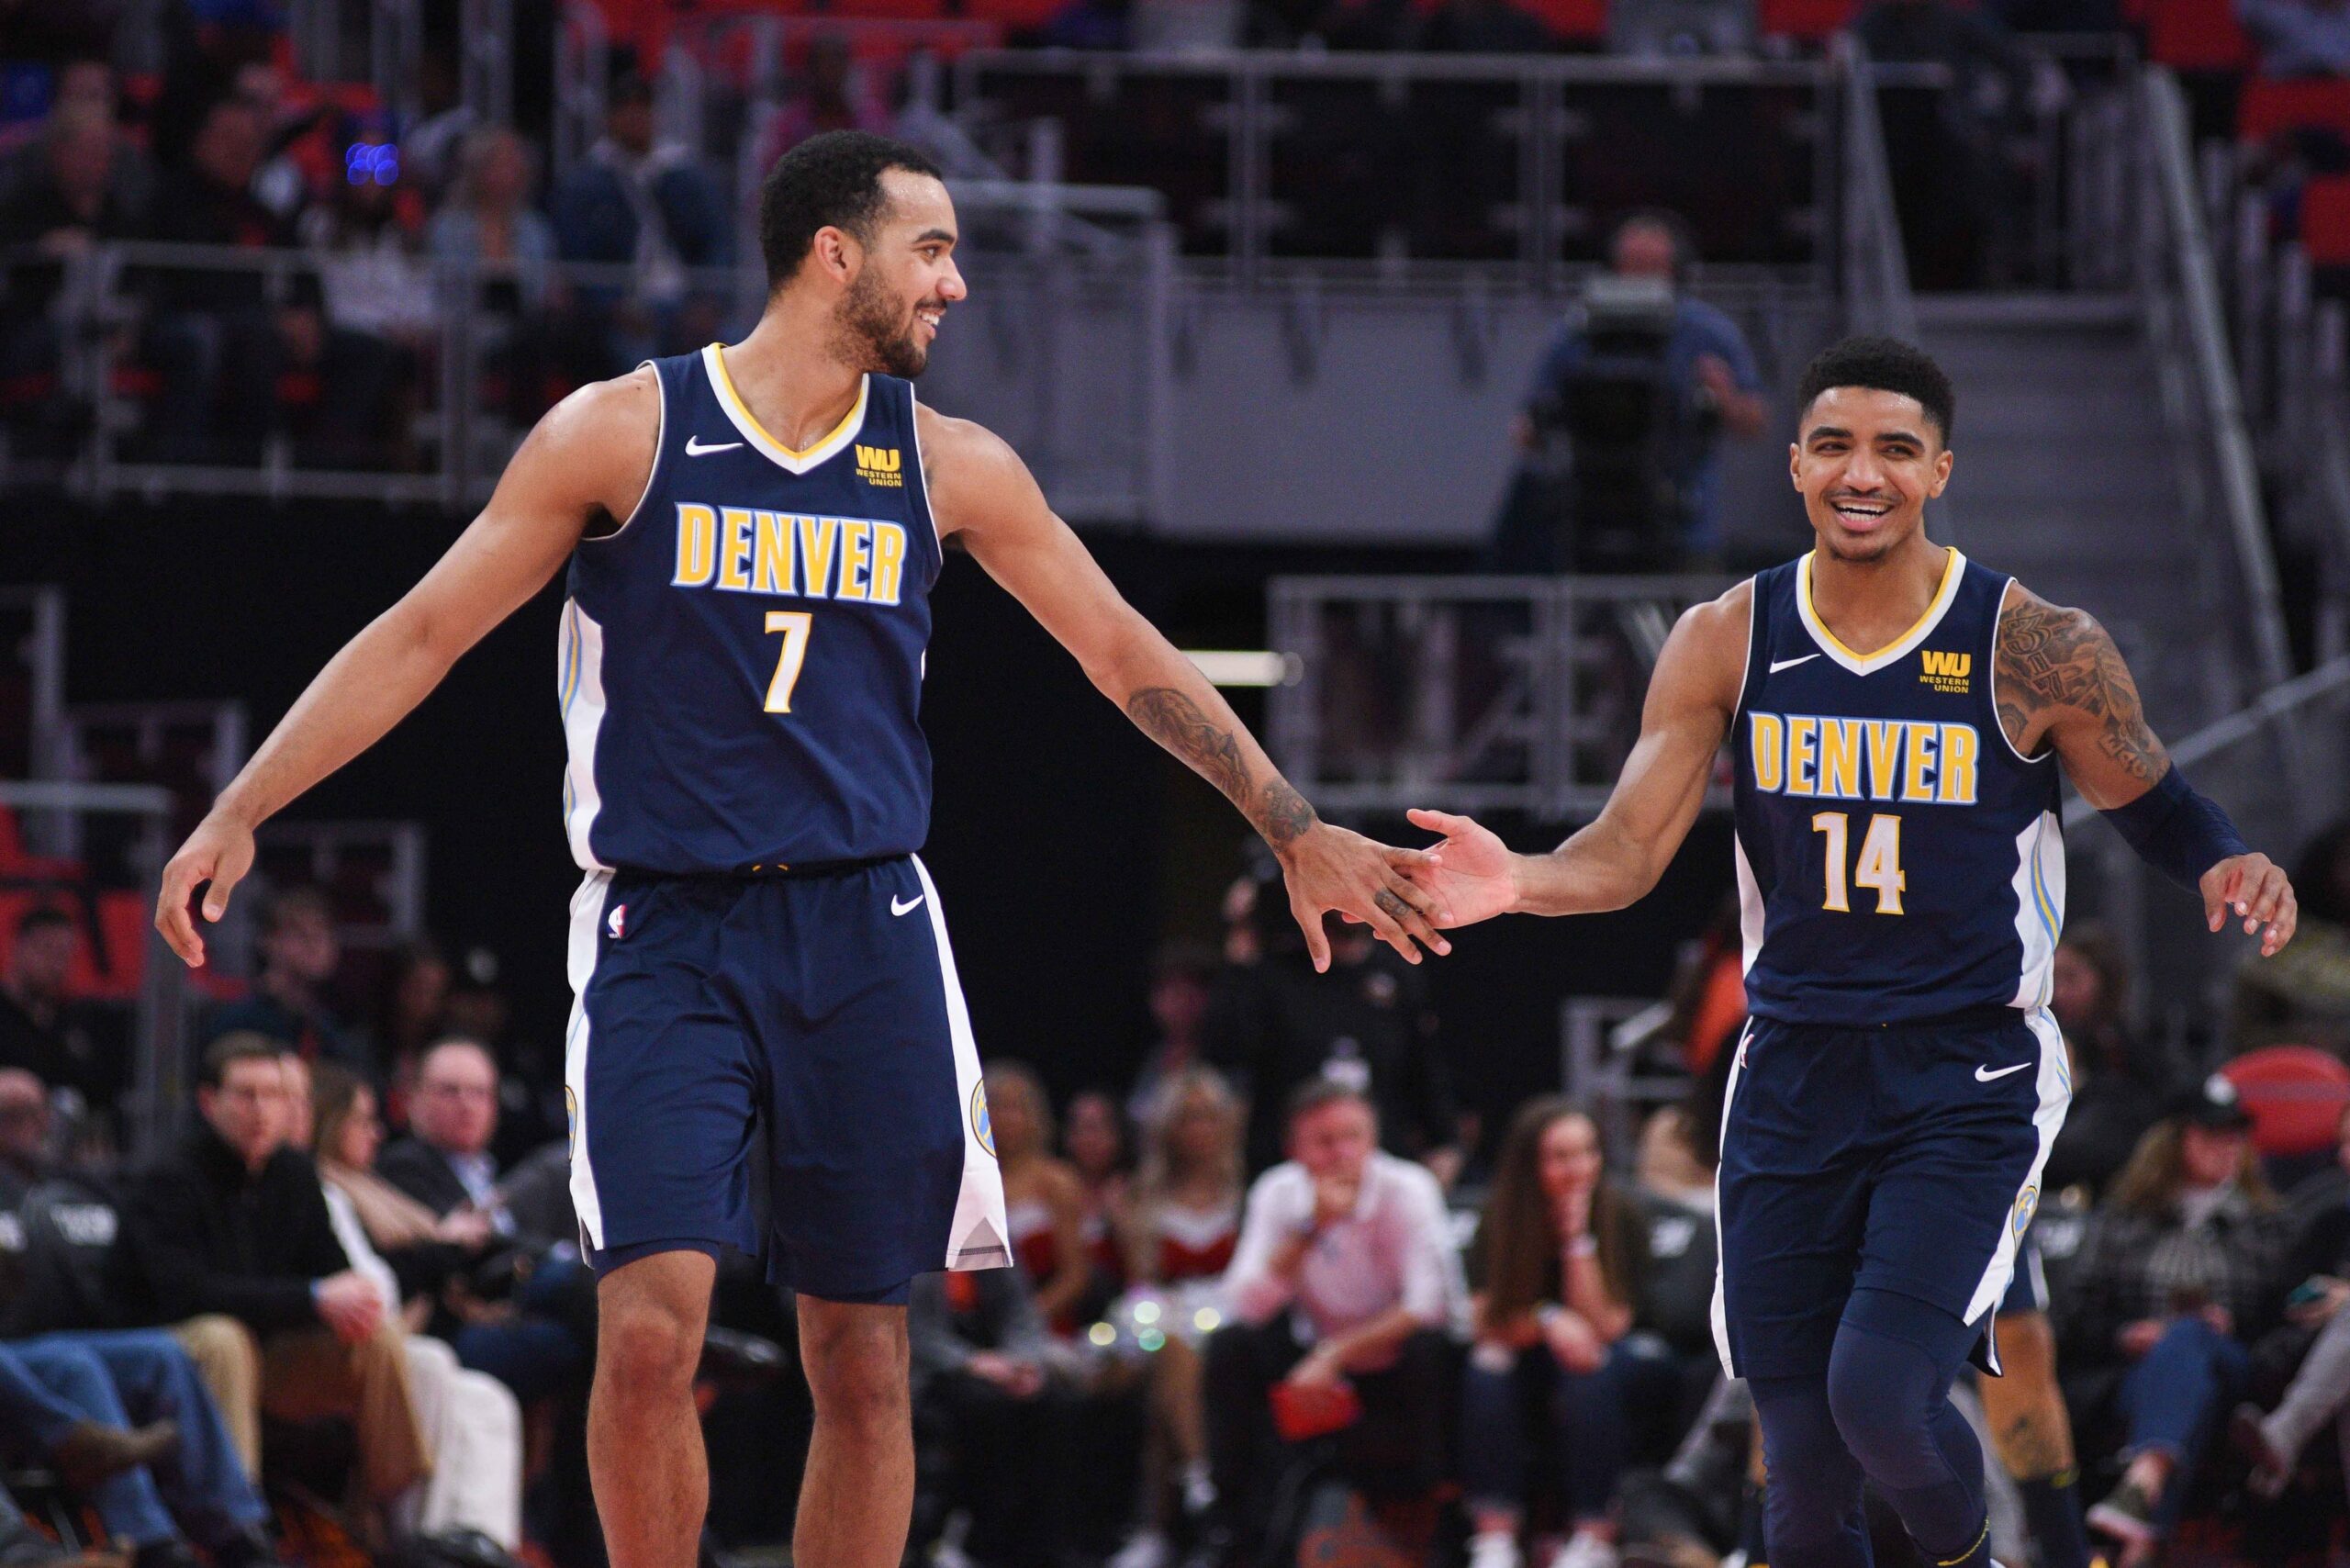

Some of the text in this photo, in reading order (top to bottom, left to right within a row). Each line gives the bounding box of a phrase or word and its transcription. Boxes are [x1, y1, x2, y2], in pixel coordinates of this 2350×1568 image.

[855, 444, 901, 471] WU
[856, 469, 901, 479] WESTERN
[868, 477, 902, 487] UNION
[670, 502, 907, 606] DENVER
[764, 611, 812, 713] 7
[1921, 651, 1971, 678] WU
[1919, 675, 1970, 686] WESTERN
[1933, 684, 1969, 694] UNION
[1748, 711, 1980, 805] DENVER
[1812, 812, 1906, 915] 14
